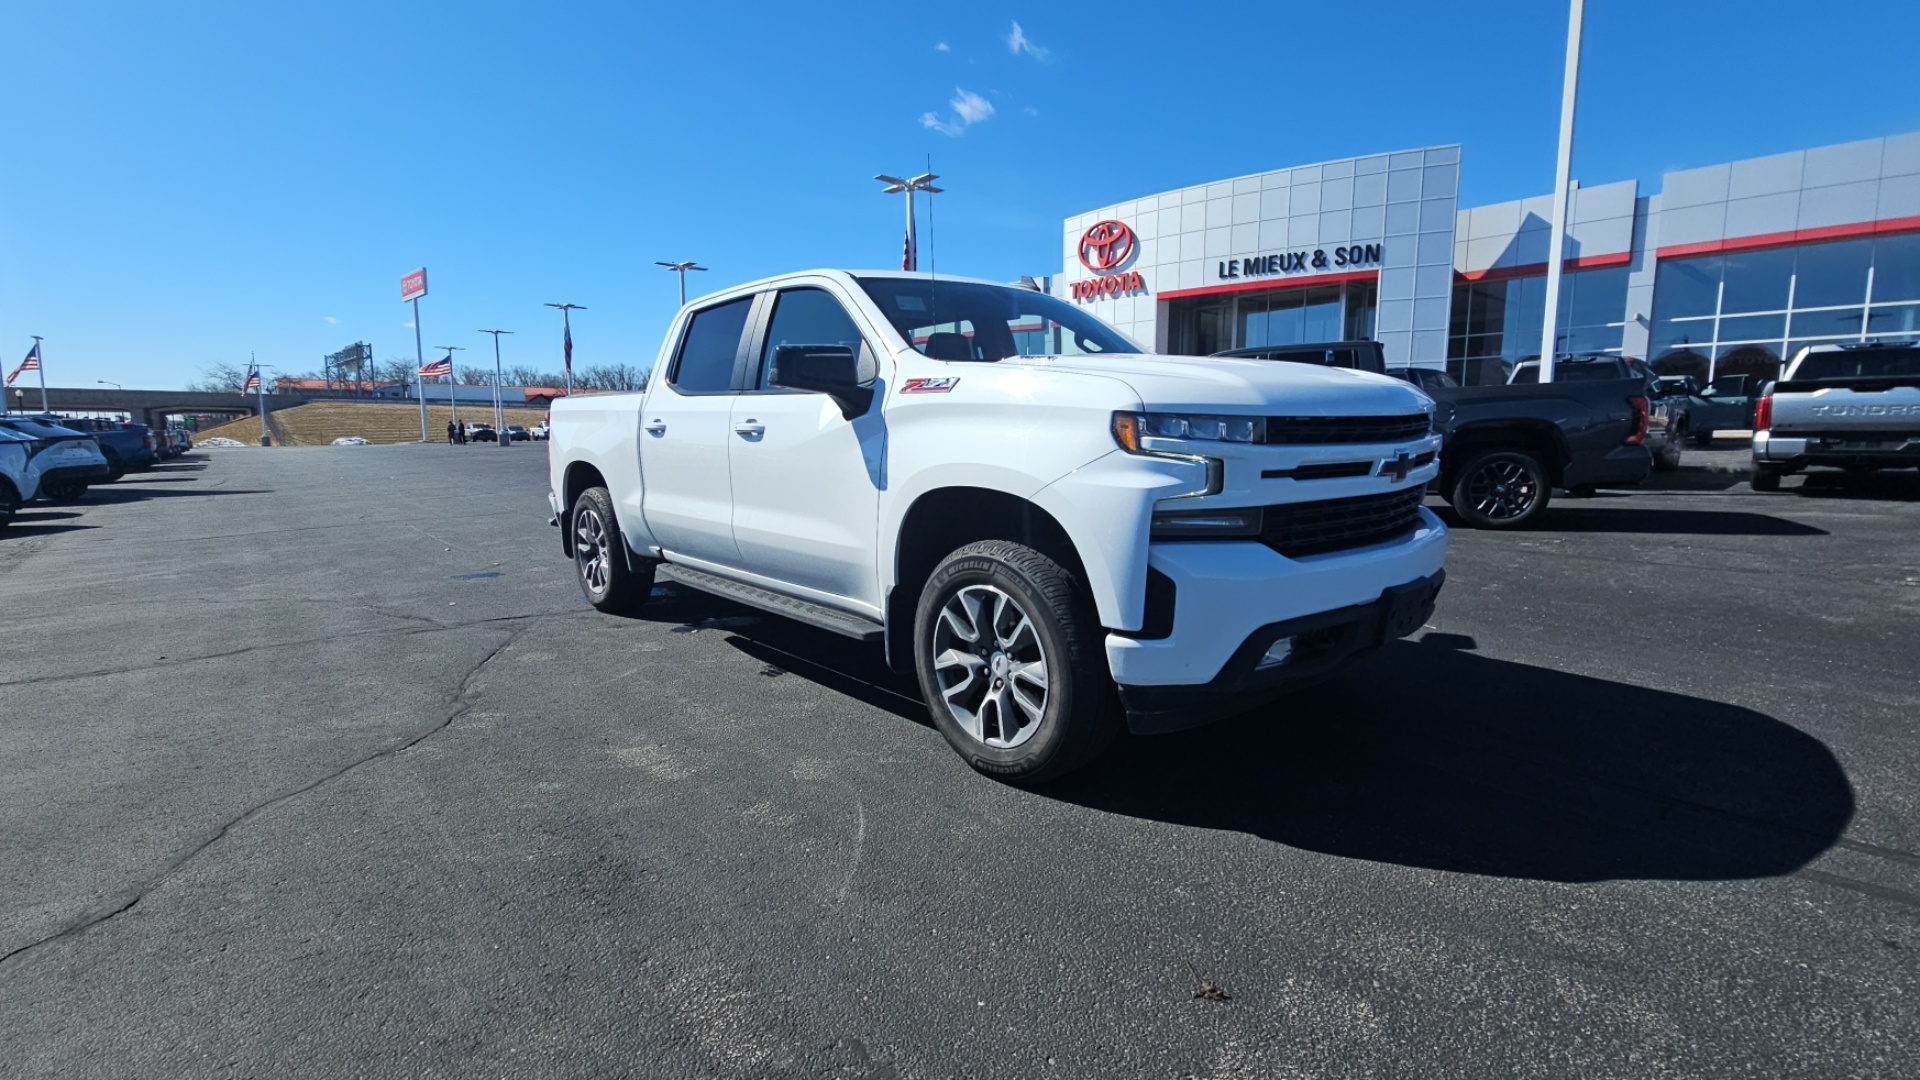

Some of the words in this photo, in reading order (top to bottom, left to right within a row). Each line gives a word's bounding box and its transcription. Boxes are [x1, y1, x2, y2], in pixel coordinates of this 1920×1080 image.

[1218, 260, 1239, 279] LE
[1243, 251, 1307, 276] MIEUX
[1311, 249, 1327, 268] &
[1334, 243, 1382, 266] SON
[1069, 271, 1143, 300] TOYOTA
[899, 376, 961, 394] Z71
[948, 560, 991, 576] MICHELIN
